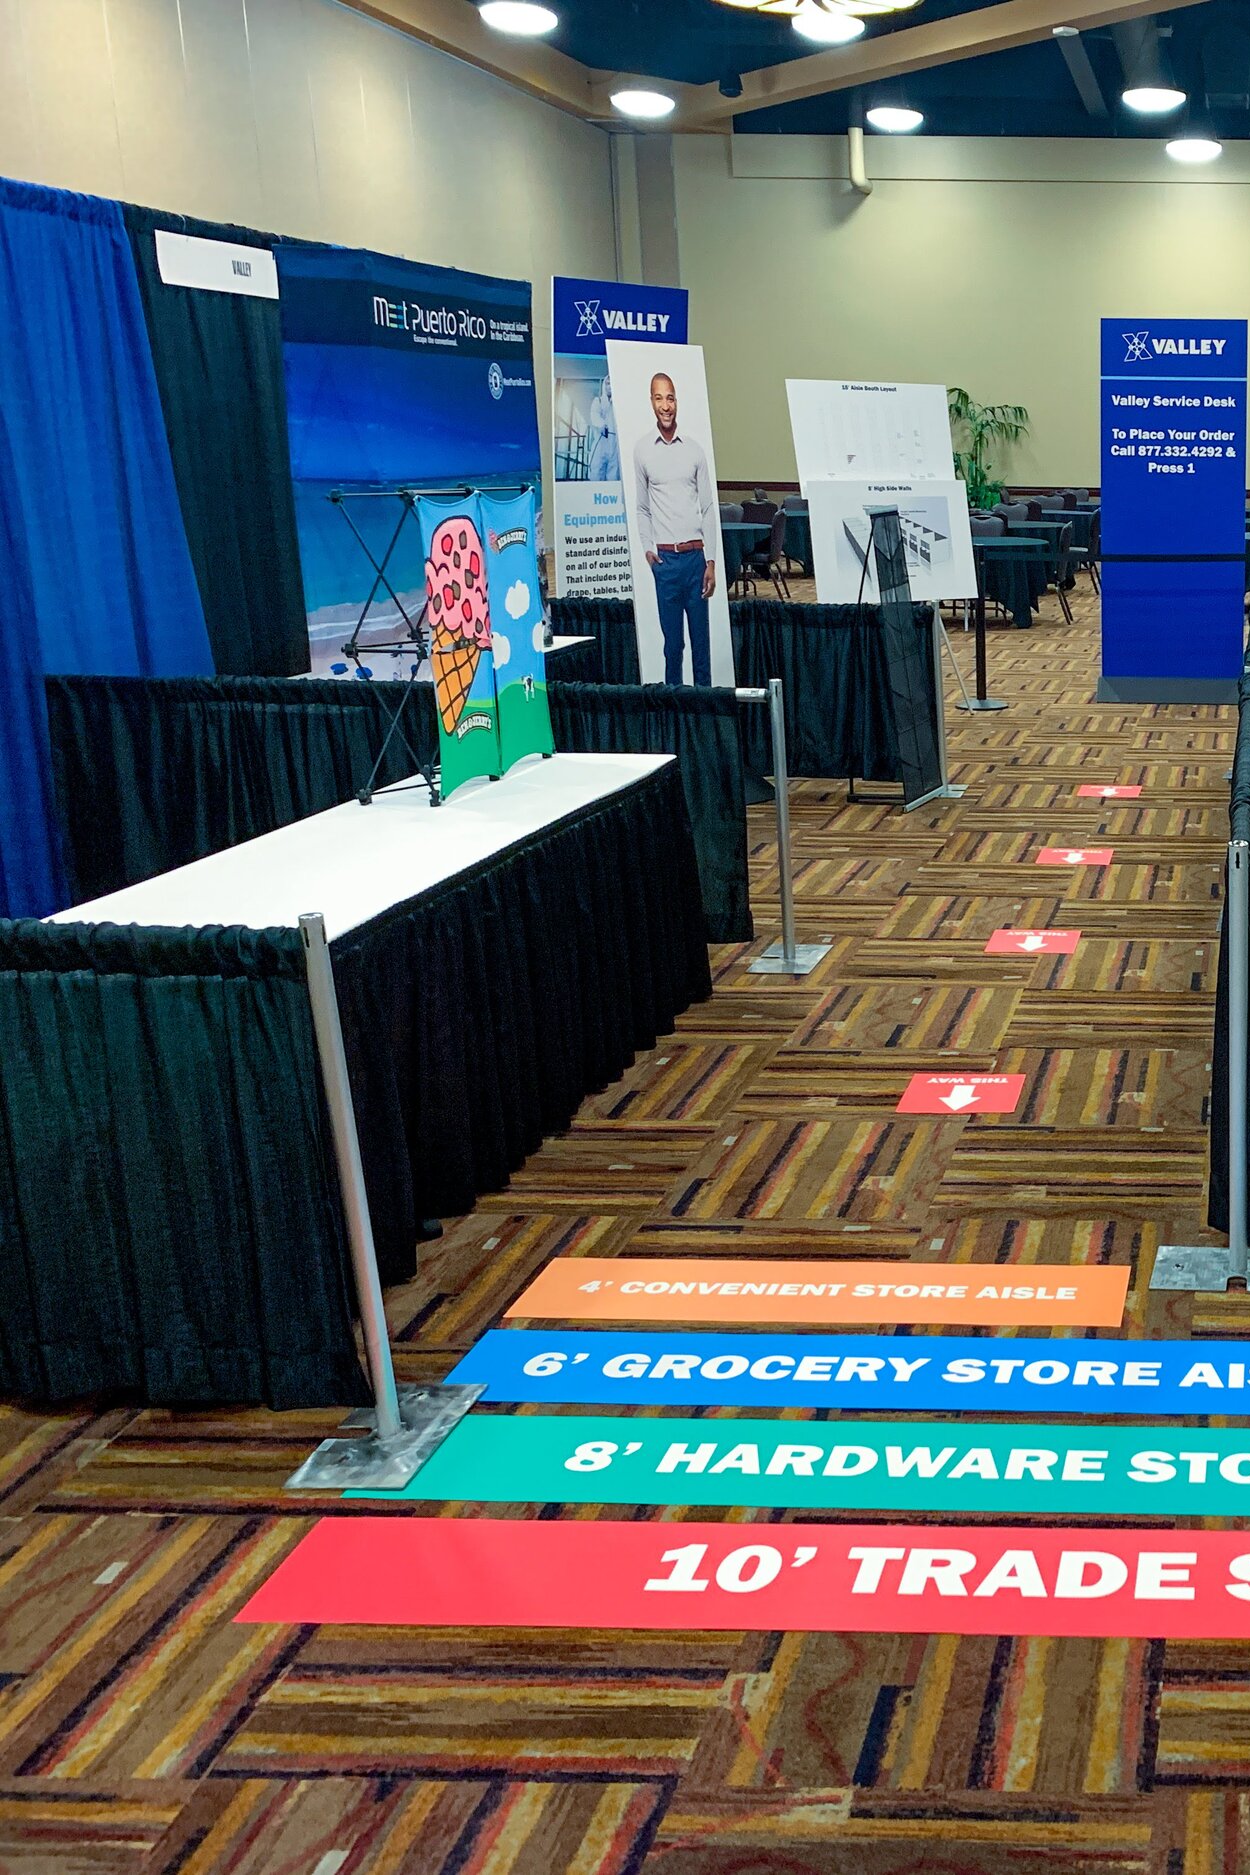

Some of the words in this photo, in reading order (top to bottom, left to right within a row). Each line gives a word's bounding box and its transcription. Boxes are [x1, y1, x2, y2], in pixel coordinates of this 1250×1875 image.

[231, 259, 252, 277] VALLEY
[411, 303, 457, 336] Puerto
[458, 309, 487, 339] Rico
[602, 309, 670, 333] VALLEY
[1151, 339, 1226, 355] VALLEY
[1111, 395, 1150, 408] Valley
[1153, 395, 1201, 407] Service
[1204, 396, 1236, 407] Desk
[1112, 428, 1126, 439] To
[1130, 428, 1165, 440] Place
[1168, 429, 1196, 440] Your
[1199, 430, 1235, 441] Order
[1111, 445, 1135, 456] Call
[1138, 445, 1222, 457] 877.332.4292
[1226, 447, 1236, 457] &
[1148, 462, 1184, 473] Press
[1187, 463, 1195, 473] 1
[593, 493, 618, 505] How
[564, 512, 626, 528] Equipment
[565, 536, 577, 544] We
[606, 534, 627, 543] indus
[565, 548, 600, 558] standard
[601, 546, 628, 556] disinfe
[578, 561, 588, 570] all
[589, 561, 597, 570] of
[599, 561, 612, 569] our
[613, 559, 631, 568] boot
[566, 575, 583, 584] That
[585, 573, 617, 583] includes
[618, 572, 631, 582] pip
[593, 586, 619, 596] tables,
[620, 584, 633, 593] tab
[577, 1280, 613, 1293] 4'
[620, 1281, 847, 1297] CONVENIENT
[851, 1284, 969, 1298] STORE
[975, 1286, 1078, 1300] AISLE
[522, 1352, 589, 1378] 6'
[601, 1353, 931, 1382] GROCERY
[941, 1358, 1163, 1387] STORE
[564, 1441, 643, 1473] 8'
[655, 1443, 1108, 1482] HARDWARE
[643, 1543, 818, 1594] 10'
[847, 1546, 1198, 1602] TRADE
